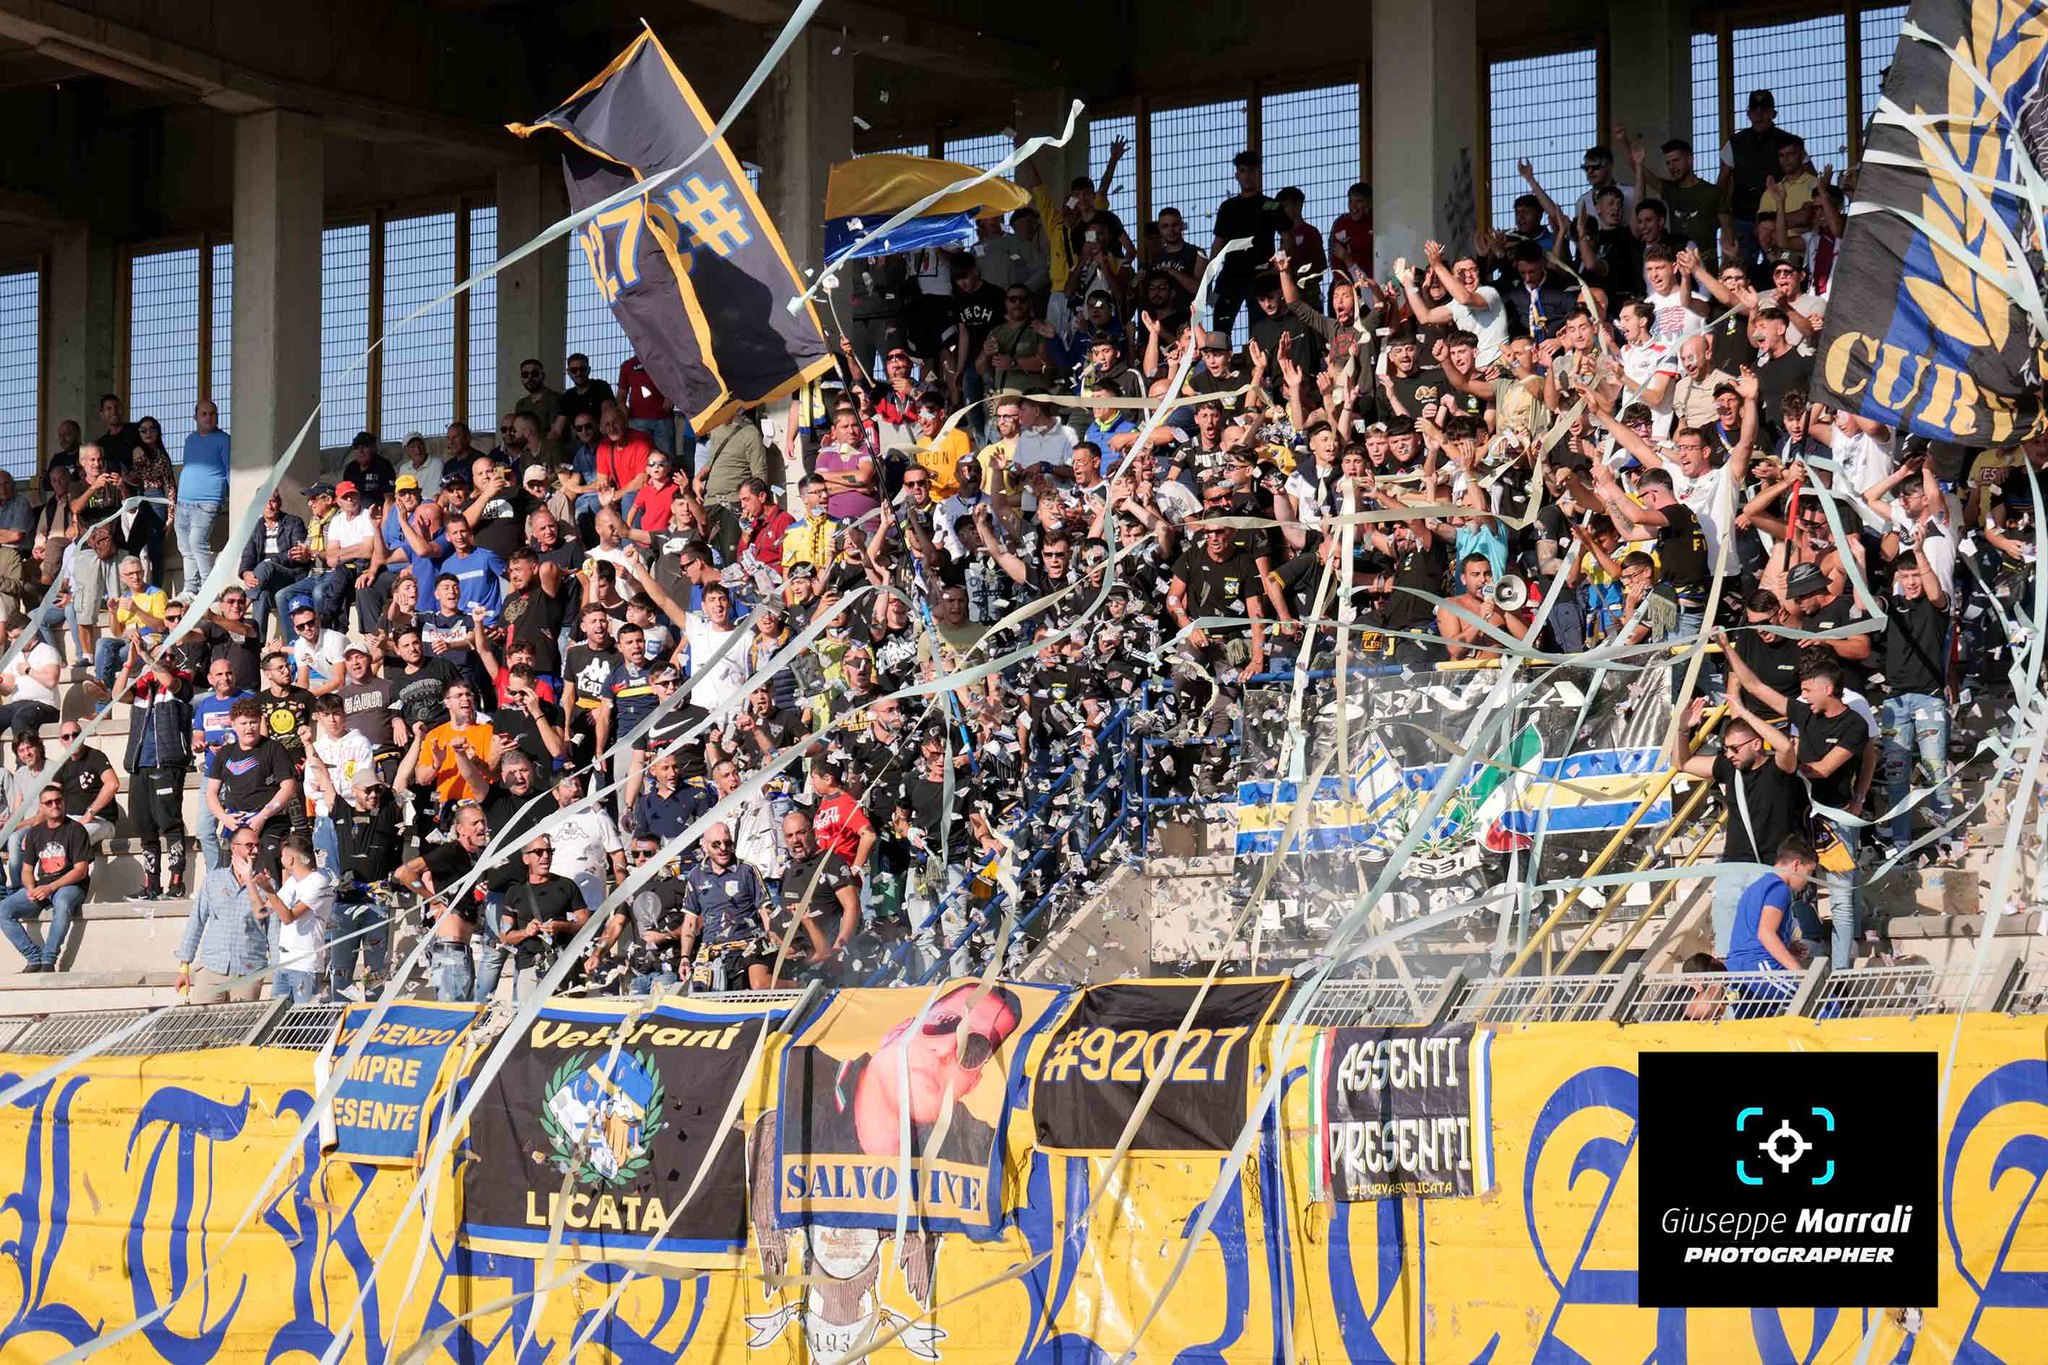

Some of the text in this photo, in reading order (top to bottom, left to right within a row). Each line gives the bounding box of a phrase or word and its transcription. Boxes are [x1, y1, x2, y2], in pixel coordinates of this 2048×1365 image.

[338, 1022, 457, 1046] VICENZO
[530, 1020, 744, 1050] Vetrani
[1043, 1026, 1249, 1081] #92027
[1337, 1037, 1461, 1092] ASSENTI
[1329, 1117, 1472, 1175] PRESENTI
[787, 1164, 898, 1201] SALVO
[526, 1190, 670, 1232] LICATA
